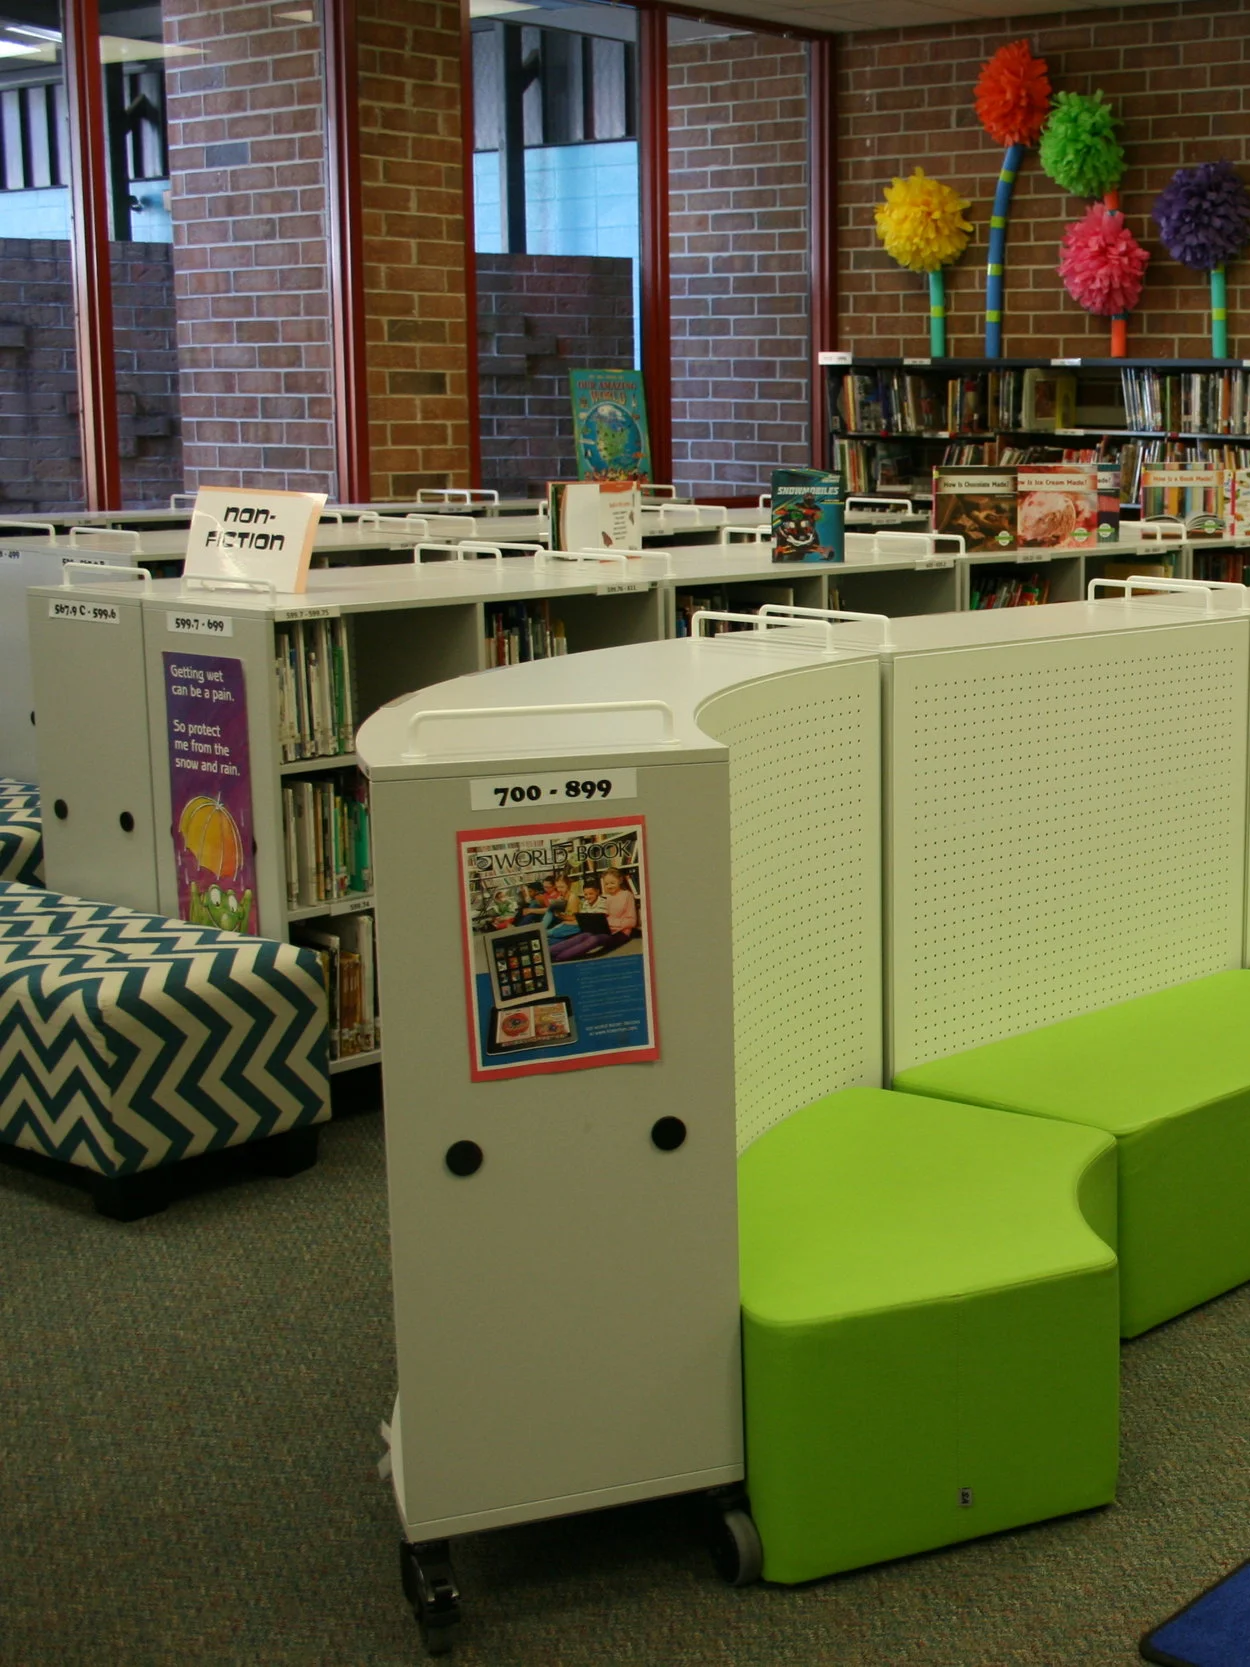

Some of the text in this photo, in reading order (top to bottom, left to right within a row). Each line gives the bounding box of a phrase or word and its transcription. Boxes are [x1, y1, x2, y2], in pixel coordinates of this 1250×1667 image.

[777, 486, 840, 496] SNOWMOBILES
[175, 617, 199, 629] 599.7
[207, 618, 225, 632] 699
[170, 665, 224, 683] Getting wet
[171, 684, 235, 702] can be a pain.
[173, 719, 221, 737] So protect
[174, 739, 230, 757] me from the
[175, 757, 241, 776] snow and rain.
[494, 785, 542, 807] 700
[565, 779, 612, 799] 899
[494, 840, 632, 870] WORLD BOOK
